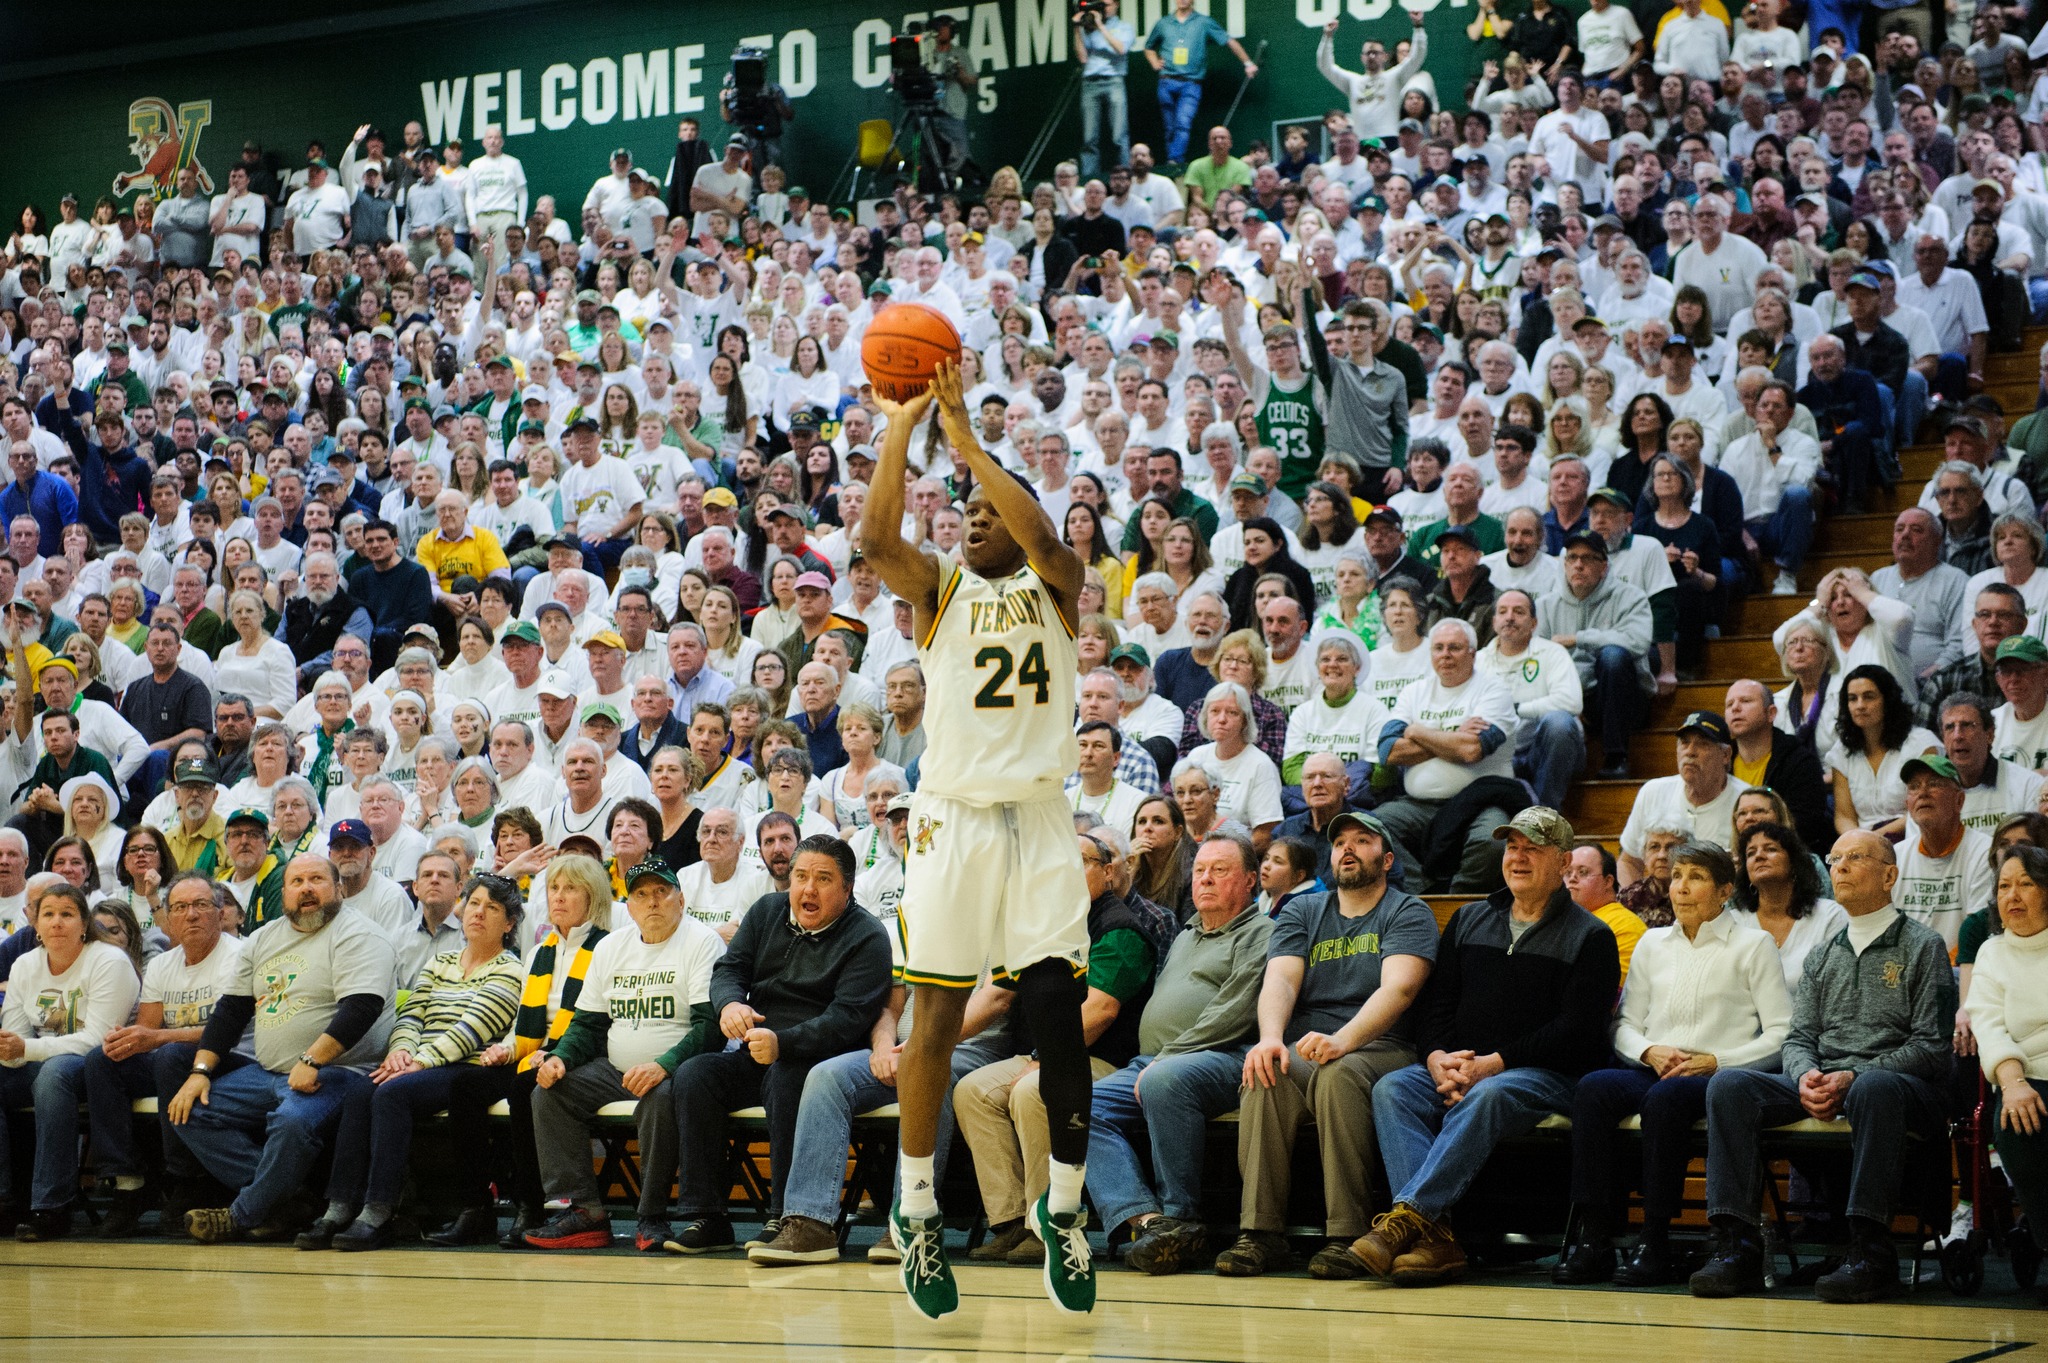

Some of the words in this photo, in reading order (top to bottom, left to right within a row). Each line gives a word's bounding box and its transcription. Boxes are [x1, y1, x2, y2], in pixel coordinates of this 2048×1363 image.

[421, 42, 705, 146] WELCOME
[977, 76, 998, 114] 5
[1267, 400, 1311, 427] CELTICS
[1269, 427, 1312, 460] 33
[970, 588, 1046, 636] VERMONT
[974, 641, 1051, 710] 24
[1306, 732, 1361, 745] EVERYTHING
[610, 995, 676, 1020] EARNED
